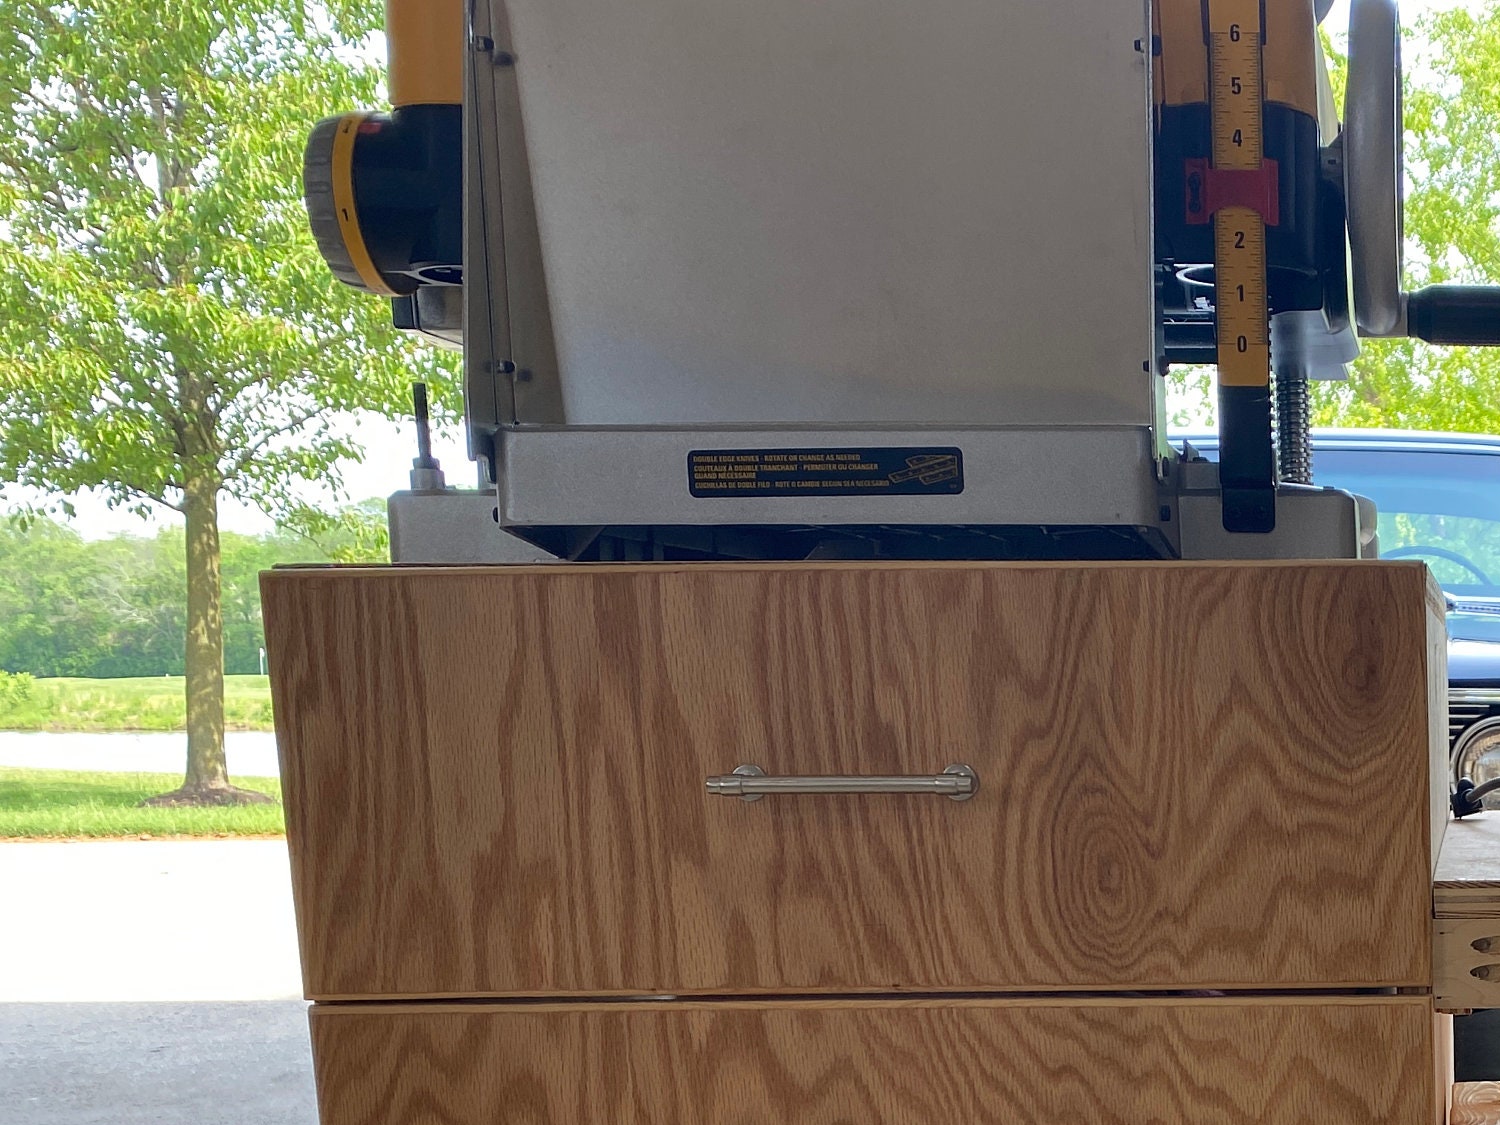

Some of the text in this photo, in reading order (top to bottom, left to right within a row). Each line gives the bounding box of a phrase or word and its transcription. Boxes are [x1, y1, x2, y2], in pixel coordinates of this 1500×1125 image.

[1229, 24, 1240, 42] 6
[1231, 76, 1242, 95] 5
[1232, 129, 1243, 147] 4
[1234, 231, 1245, 249] 2
[1236, 284, 1244, 302] 1
[1237, 335, 1247, 353] 0
